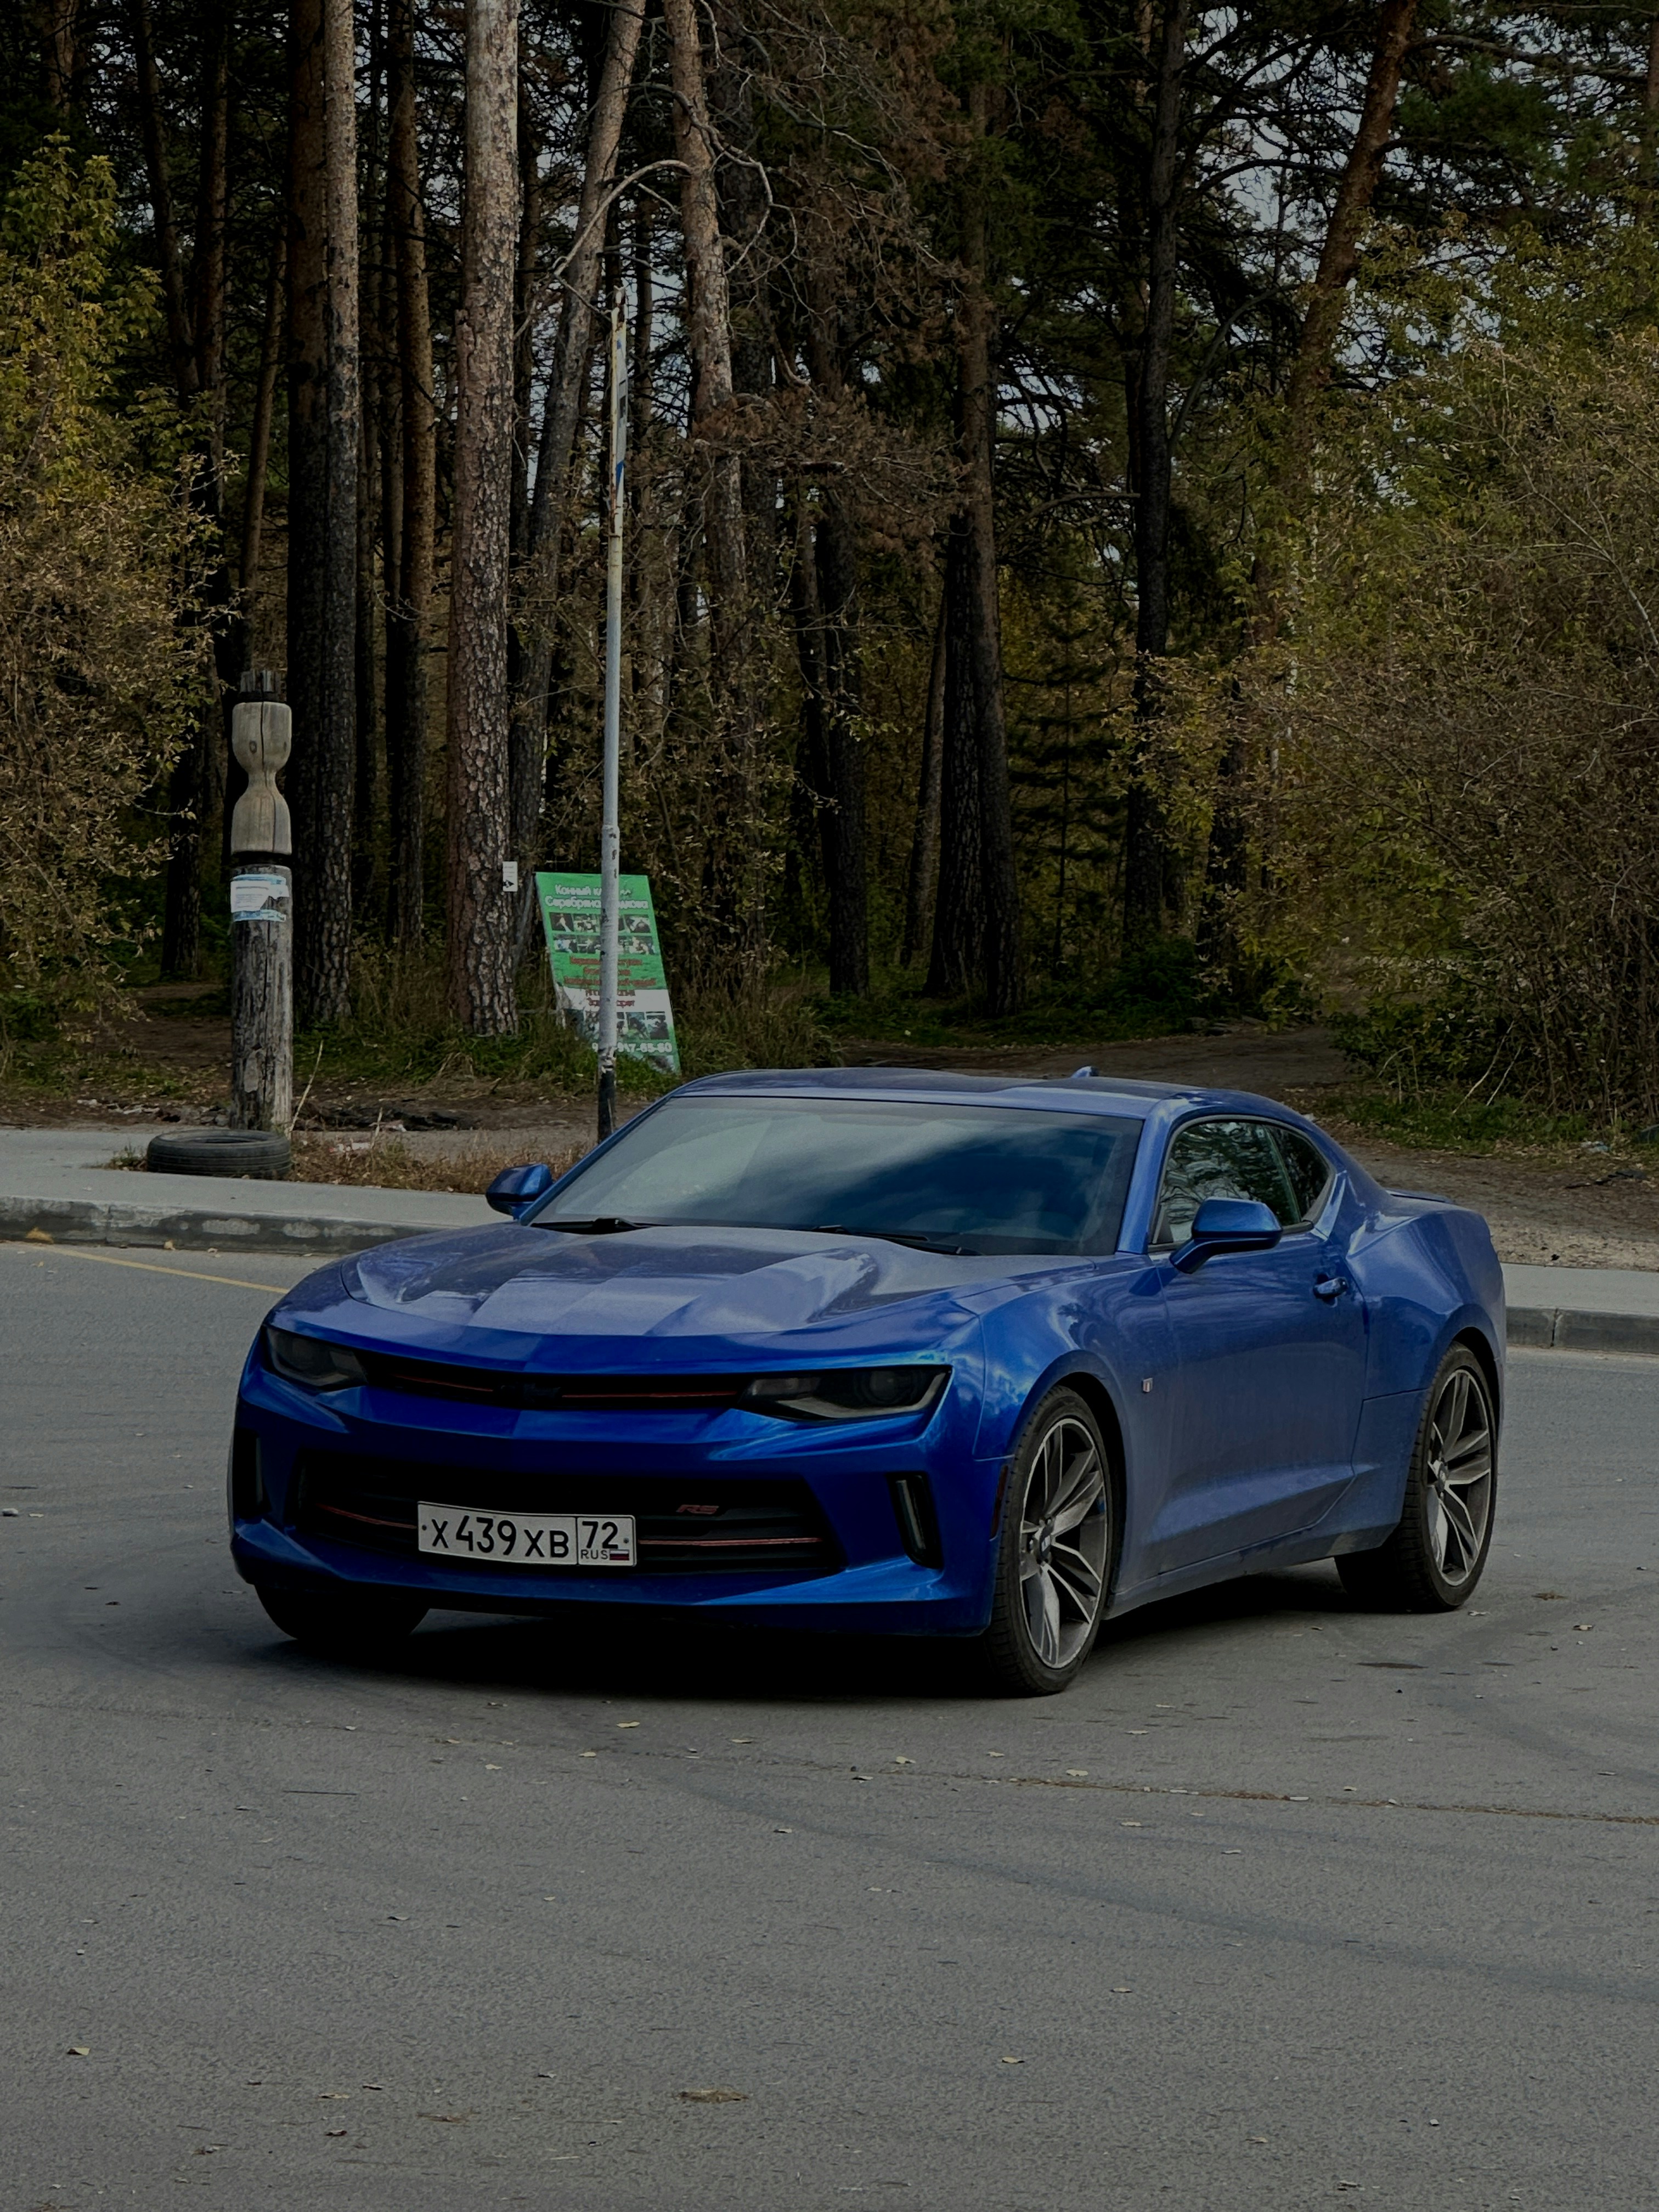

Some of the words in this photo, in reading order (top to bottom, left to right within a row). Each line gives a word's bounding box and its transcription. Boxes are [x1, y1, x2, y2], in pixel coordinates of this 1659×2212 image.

[676, 1504, 719, 1515] RS
[582, 1521, 618, 1549] 72
[580, 1549, 608, 1560] RUS
